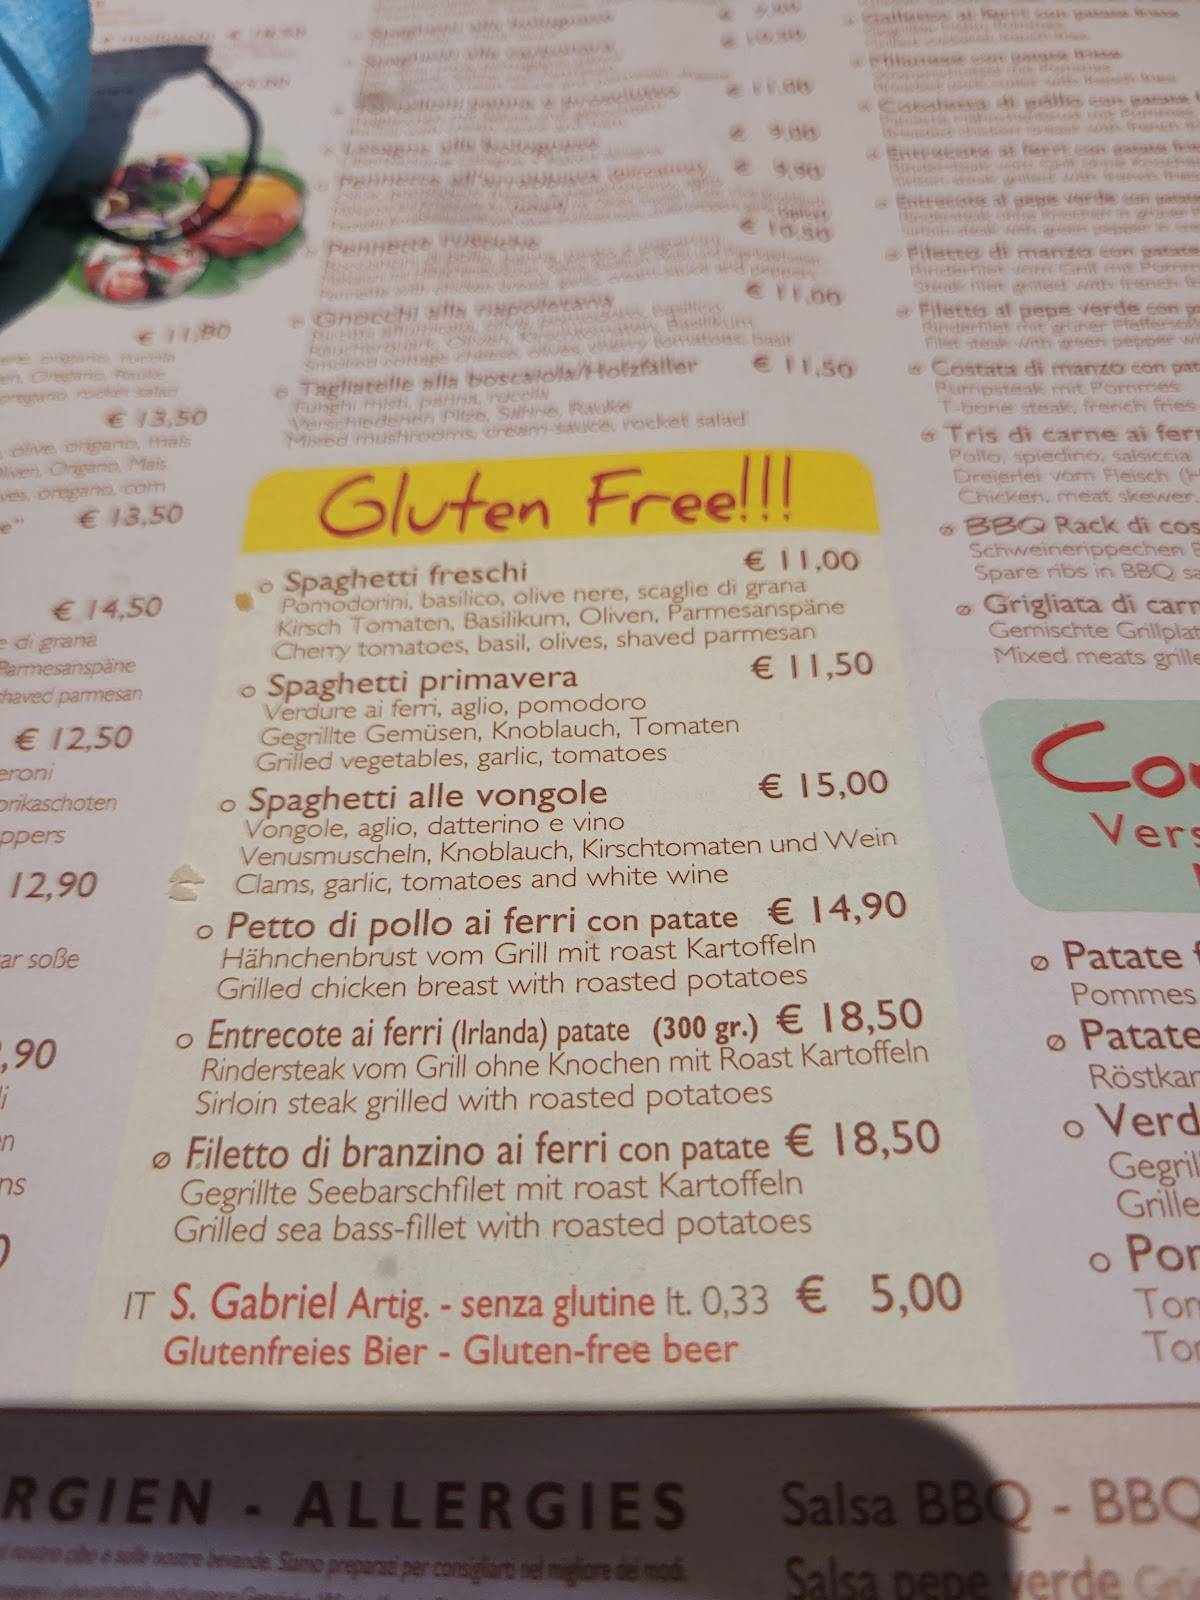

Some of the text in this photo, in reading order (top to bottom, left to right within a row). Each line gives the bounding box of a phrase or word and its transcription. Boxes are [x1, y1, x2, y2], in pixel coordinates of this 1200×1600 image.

[103, 407, 127, 429] €
[943, 421, 1000, 444] Tris
[1007, 423, 1033, 444] di
[1041, 426, 1119, 443] carne
[1124, 424, 1150, 443] ai
[319, 455, 794, 537] Gluten Free!!!
[75, 508, 100, 530] €
[963, 514, 1048, 537] BBQ
[1053, 513, 1120, 534] Rack
[1126, 515, 1151, 534] di
[284, 549, 860, 595] Spaghetti freschi € 11,00
[50, 594, 163, 622] € 14,50
[279, 578, 808, 614] Pomodorini, basilico, olive nere, scaglie di grana
[982, 591, 1104, 620] Grigliata
[1111, 592, 1137, 614] di
[274, 598, 845, 637] Kirsch Tomaten, Basilikum, Oliven, Parmesanspäne
[39, 632, 97, 654] grana
[993, 645, 1072, 664] Mixed
[1075, 649, 1148, 665] meats
[267, 650, 874, 703] Spaghetti primavera € 11,50
[56, 687, 143, 707] parmesan
[264, 692, 646, 721] Verdure ai ferri, aglio, pomodoro
[13, 724, 133, 753] € 12,50
[248, 769, 888, 819] Spaghetti alle vongole € 15,00
[245, 810, 624, 842] Vongole, aglio, datterino e vino
[240, 827, 897, 866] Venusmuscheln, Knoblauch, Kirschtomaten und Wein
[10, 870, 98, 902] 12,90
[227, 890, 907, 943] Petto di pollo ai ferri con patate € 14,90
[27, 946, 80, 969] soße
[221, 932, 816, 969] Hähnchenbrust vom Grill mit roast Kartoffeln
[1062, 940, 1184, 970] Patate
[1070, 981, 1197, 1006] Pommes
[207, 997, 923, 1051] Entrecote ai ferri (Irlanda) patate (300 gr.) € 18,50
[186, 1118, 941, 1170] Filetto di branzino ai ferri con patate € 18,50
[123, 1271, 963, 1327] IT S. Gabriel Artig. - senza glutine lt. 0,33 € 5,00
[163, 1334, 351, 1366] Glutenfreies
[363, 1334, 429, 1366] Bier
[463, 1332, 651, 1366] Gluten-free
[663, 1331, 739, 1364] beer
[292, 1480, 686, 1532] ALLERGIES
[782, 1480, 897, 1526] Salsa
[917, 1479, 1033, 1533] BBQ
[1052, 1504, 1072, 1515] -
